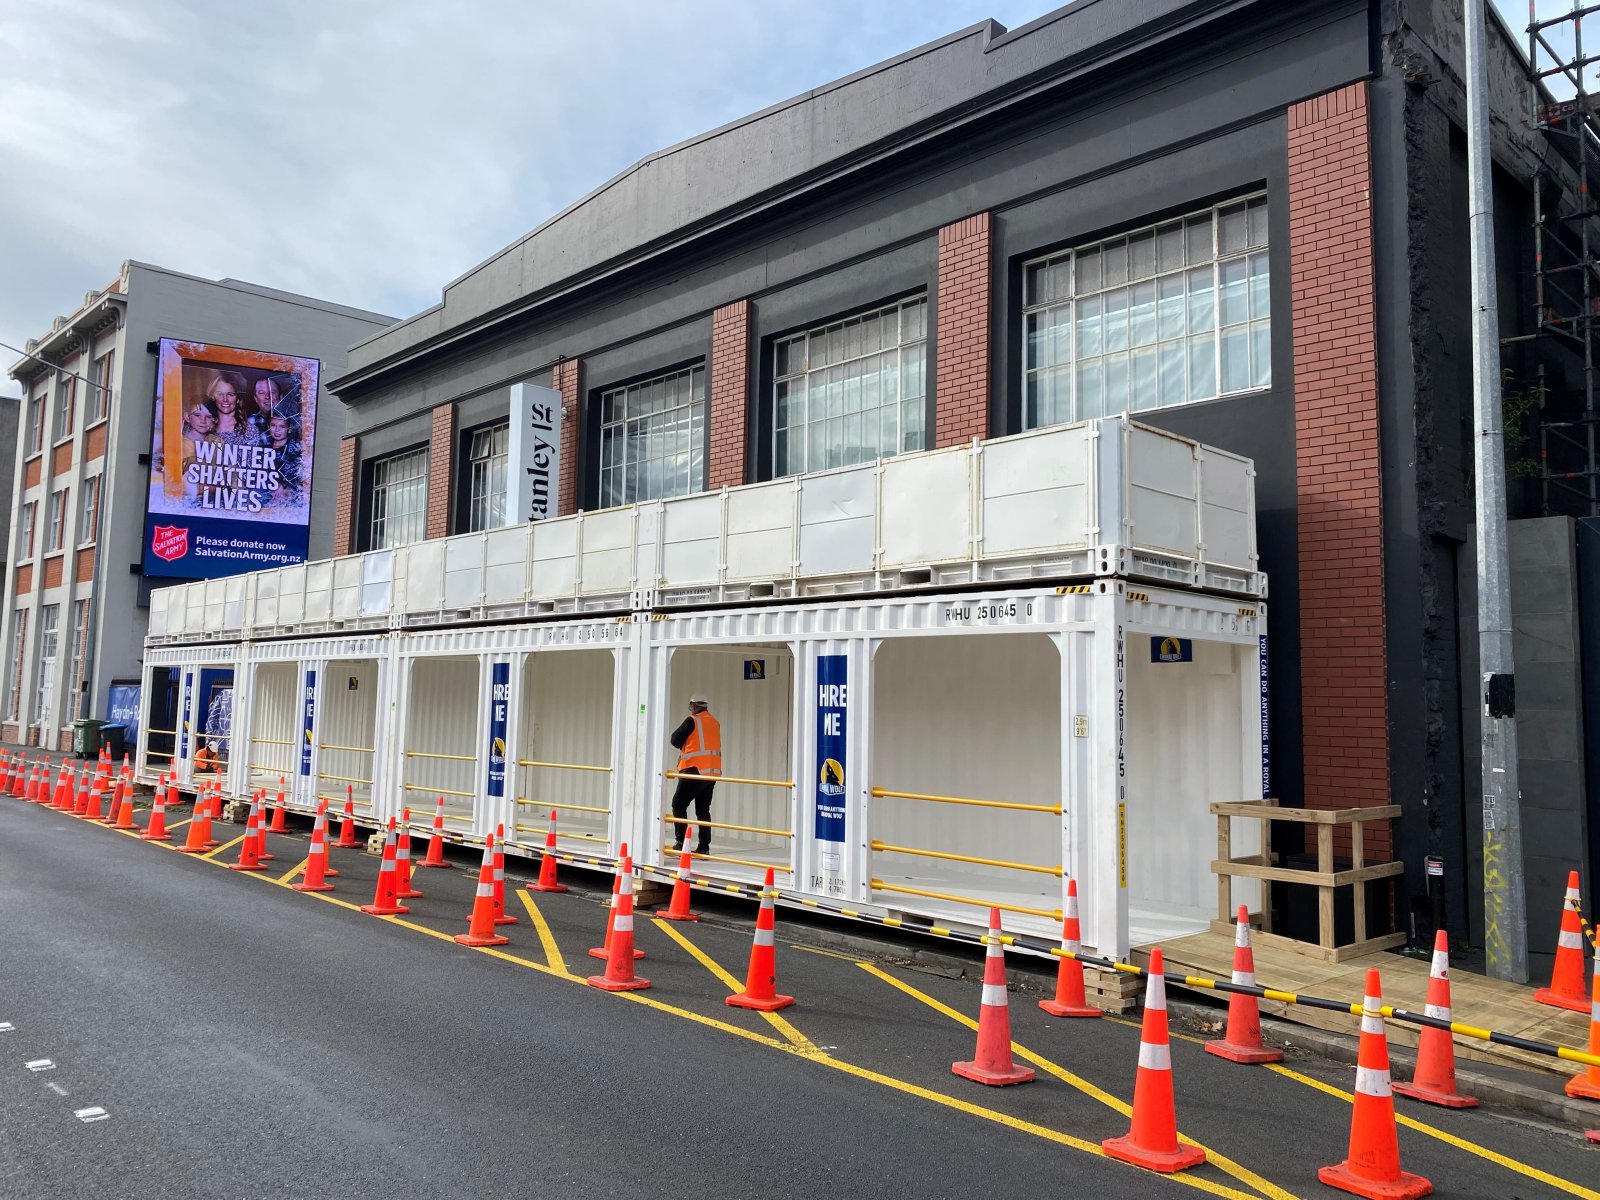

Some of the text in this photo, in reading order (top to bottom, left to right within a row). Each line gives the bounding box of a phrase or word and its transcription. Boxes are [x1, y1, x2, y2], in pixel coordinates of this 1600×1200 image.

[194, 440, 277, 470] WINTER
[526, 402, 556, 521] tanley St
[187, 463, 280, 491] SHATTERS
[202, 486, 262, 513] LIVES
[154, 531, 187, 552] SALVATION
[160, 529, 174, 540] THE
[196, 535, 286, 551] Please donate now
[164, 541, 185, 557] ARMY
[195, 547, 301, 564] SalvationArmy.org.nz
[977, 603, 1016, 620] 250645
[1116, 625, 1125, 683] RWHU
[1260, 638, 1268, 656] YOU
[1260, 659, 1268, 677] CAN
[1261, 680, 1268, 693] DO
[1261, 696, 1269, 741] ANYTHING
[1118, 688, 1126, 778] 250645
[1262, 744, 1269, 754] IN
